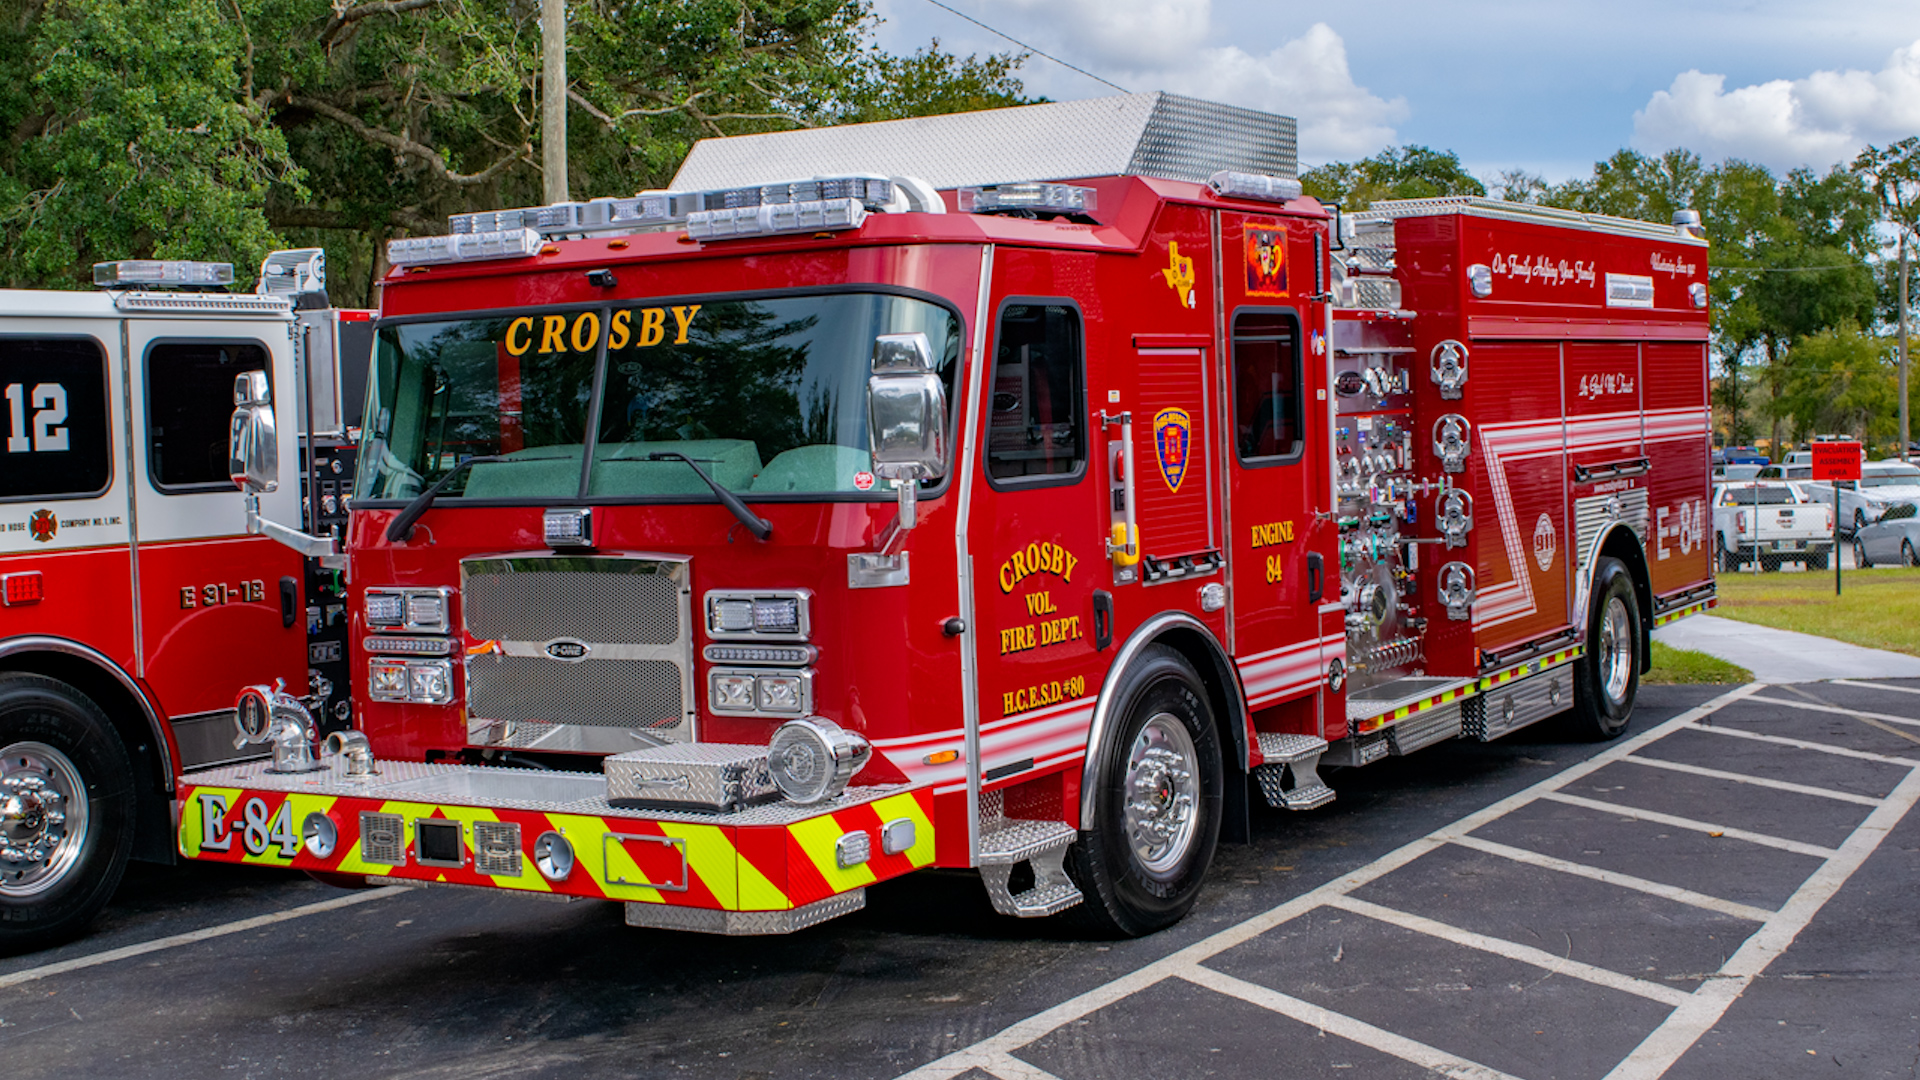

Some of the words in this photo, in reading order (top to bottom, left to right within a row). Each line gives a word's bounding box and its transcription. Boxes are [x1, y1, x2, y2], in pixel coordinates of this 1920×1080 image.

[1492, 252, 1507, 274] Our
[1507, 254, 1532, 284] Family
[1558, 259, 1574, 285] Your
[1574, 260, 1596, 288] Family
[1187, 289, 1196, 309] 4
[504, 304, 702, 358] CROSBY
[4, 382, 71, 453] 12
[1814, 446, 1861, 454] EVACUATION
[60, 518, 91, 528] COMPANY
[1250, 520, 1295, 550] ENGINE
[1656, 499, 1703, 561] E-84
[998, 541, 1079, 595] CROSBY
[1266, 554, 1283, 585] 84
[180, 586, 197, 609] E
[1025, 591, 1057, 617] VOL.
[550, 644, 582, 656] E-ONE
[1000, 624, 1037, 656] FIRE
[1040, 615, 1083, 648] DEPT.
[197, 793, 298, 859] E-84
